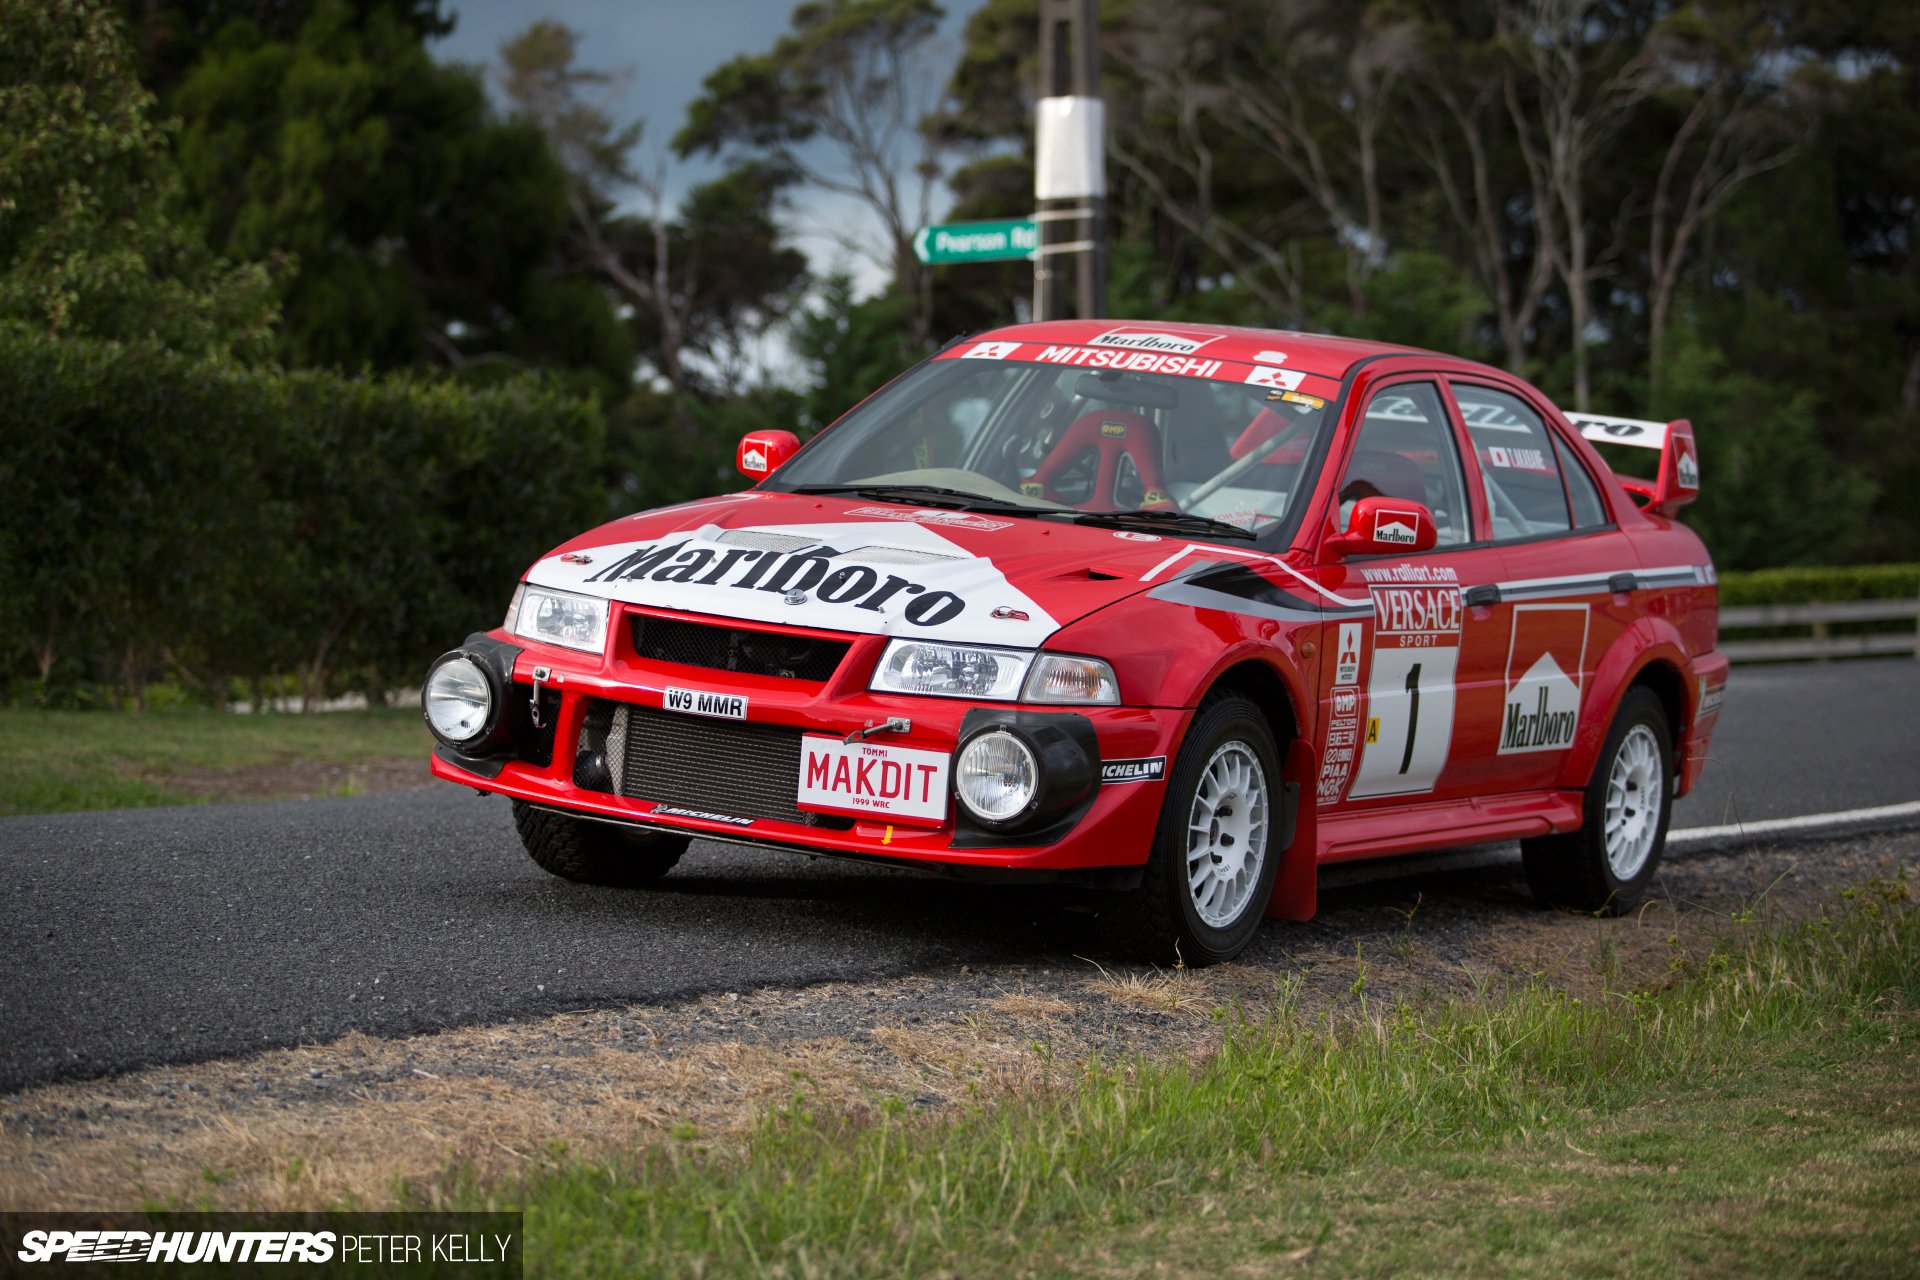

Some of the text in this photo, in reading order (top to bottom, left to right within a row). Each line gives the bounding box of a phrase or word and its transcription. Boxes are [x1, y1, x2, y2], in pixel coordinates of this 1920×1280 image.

[936, 226, 1037, 252] Pearson Rd
[1097, 333, 1195, 351] Marlboro
[1034, 346, 1222, 377] MITSUBISHI
[1376, 528, 1415, 543] Marlboro
[1360, 563, 1458, 582] www.ralliart.com
[583, 539, 965, 627] Marlboro
[1373, 589, 1460, 630] VERSACE
[1399, 635, 1438, 647] SPORT
[668, 689, 743, 716] W9 MMR
[1336, 694, 1355, 712] OMP
[1398, 663, 1422, 774] 1
[1501, 686, 1575, 749] Marlboro
[1367, 719, 1377, 742] A
[862, 747, 888, 758] TOMMI
[807, 751, 938, 803] MAKDIT
[1101, 762, 1163, 777] ICHELIN
[1321, 763, 1348, 778] PIAA
[1316, 777, 1345, 796] NGK
[852, 797, 890, 809] 1999 WRC
[666, 807, 755, 825] MICHELIN
